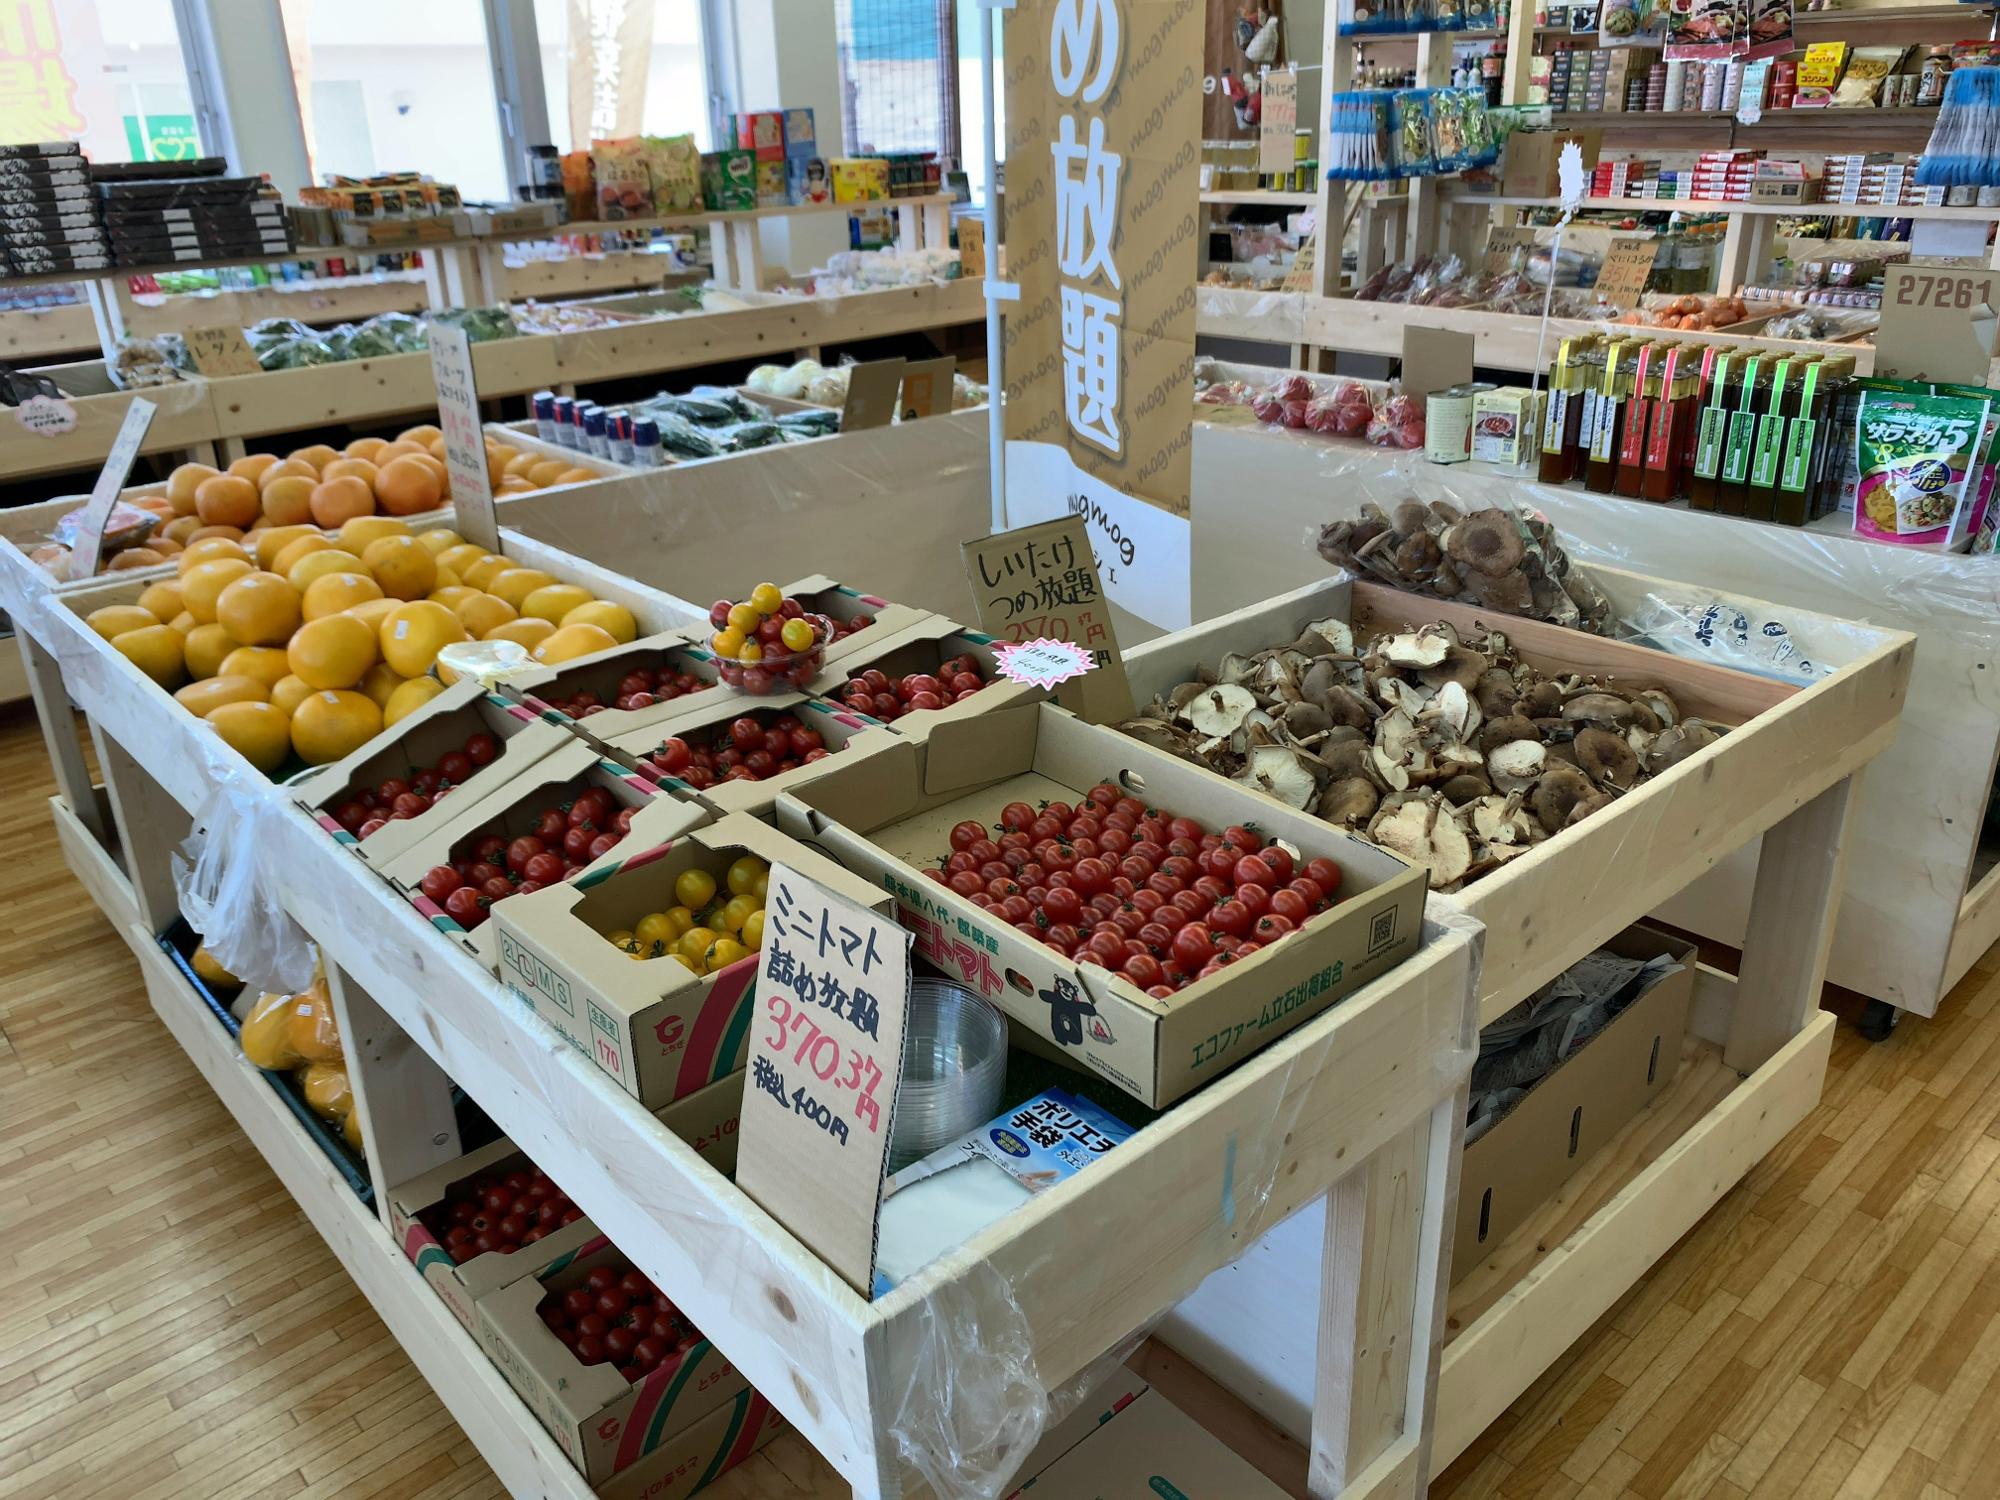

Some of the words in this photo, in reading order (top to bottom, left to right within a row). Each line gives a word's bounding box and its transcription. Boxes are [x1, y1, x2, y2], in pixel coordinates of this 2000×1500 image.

[1050, 0, 1122, 454] め放題
[1131, 213, 1196, 290] mogmog
[1897, 274, 1992, 309] 27261
[978, 535, 1075, 588] しいたけ
[988, 566, 1098, 620] つめ放題
[772, 882, 883, 976] ミニトマト
[538, 967, 551, 992] M
[557, 982, 568, 1005] S
[1191, 959, 1345, 1070] エコファーム立石出荷組合
[597, 1038, 621, 1073] 170
[1010, 1110, 1064, 1149] 手袋
